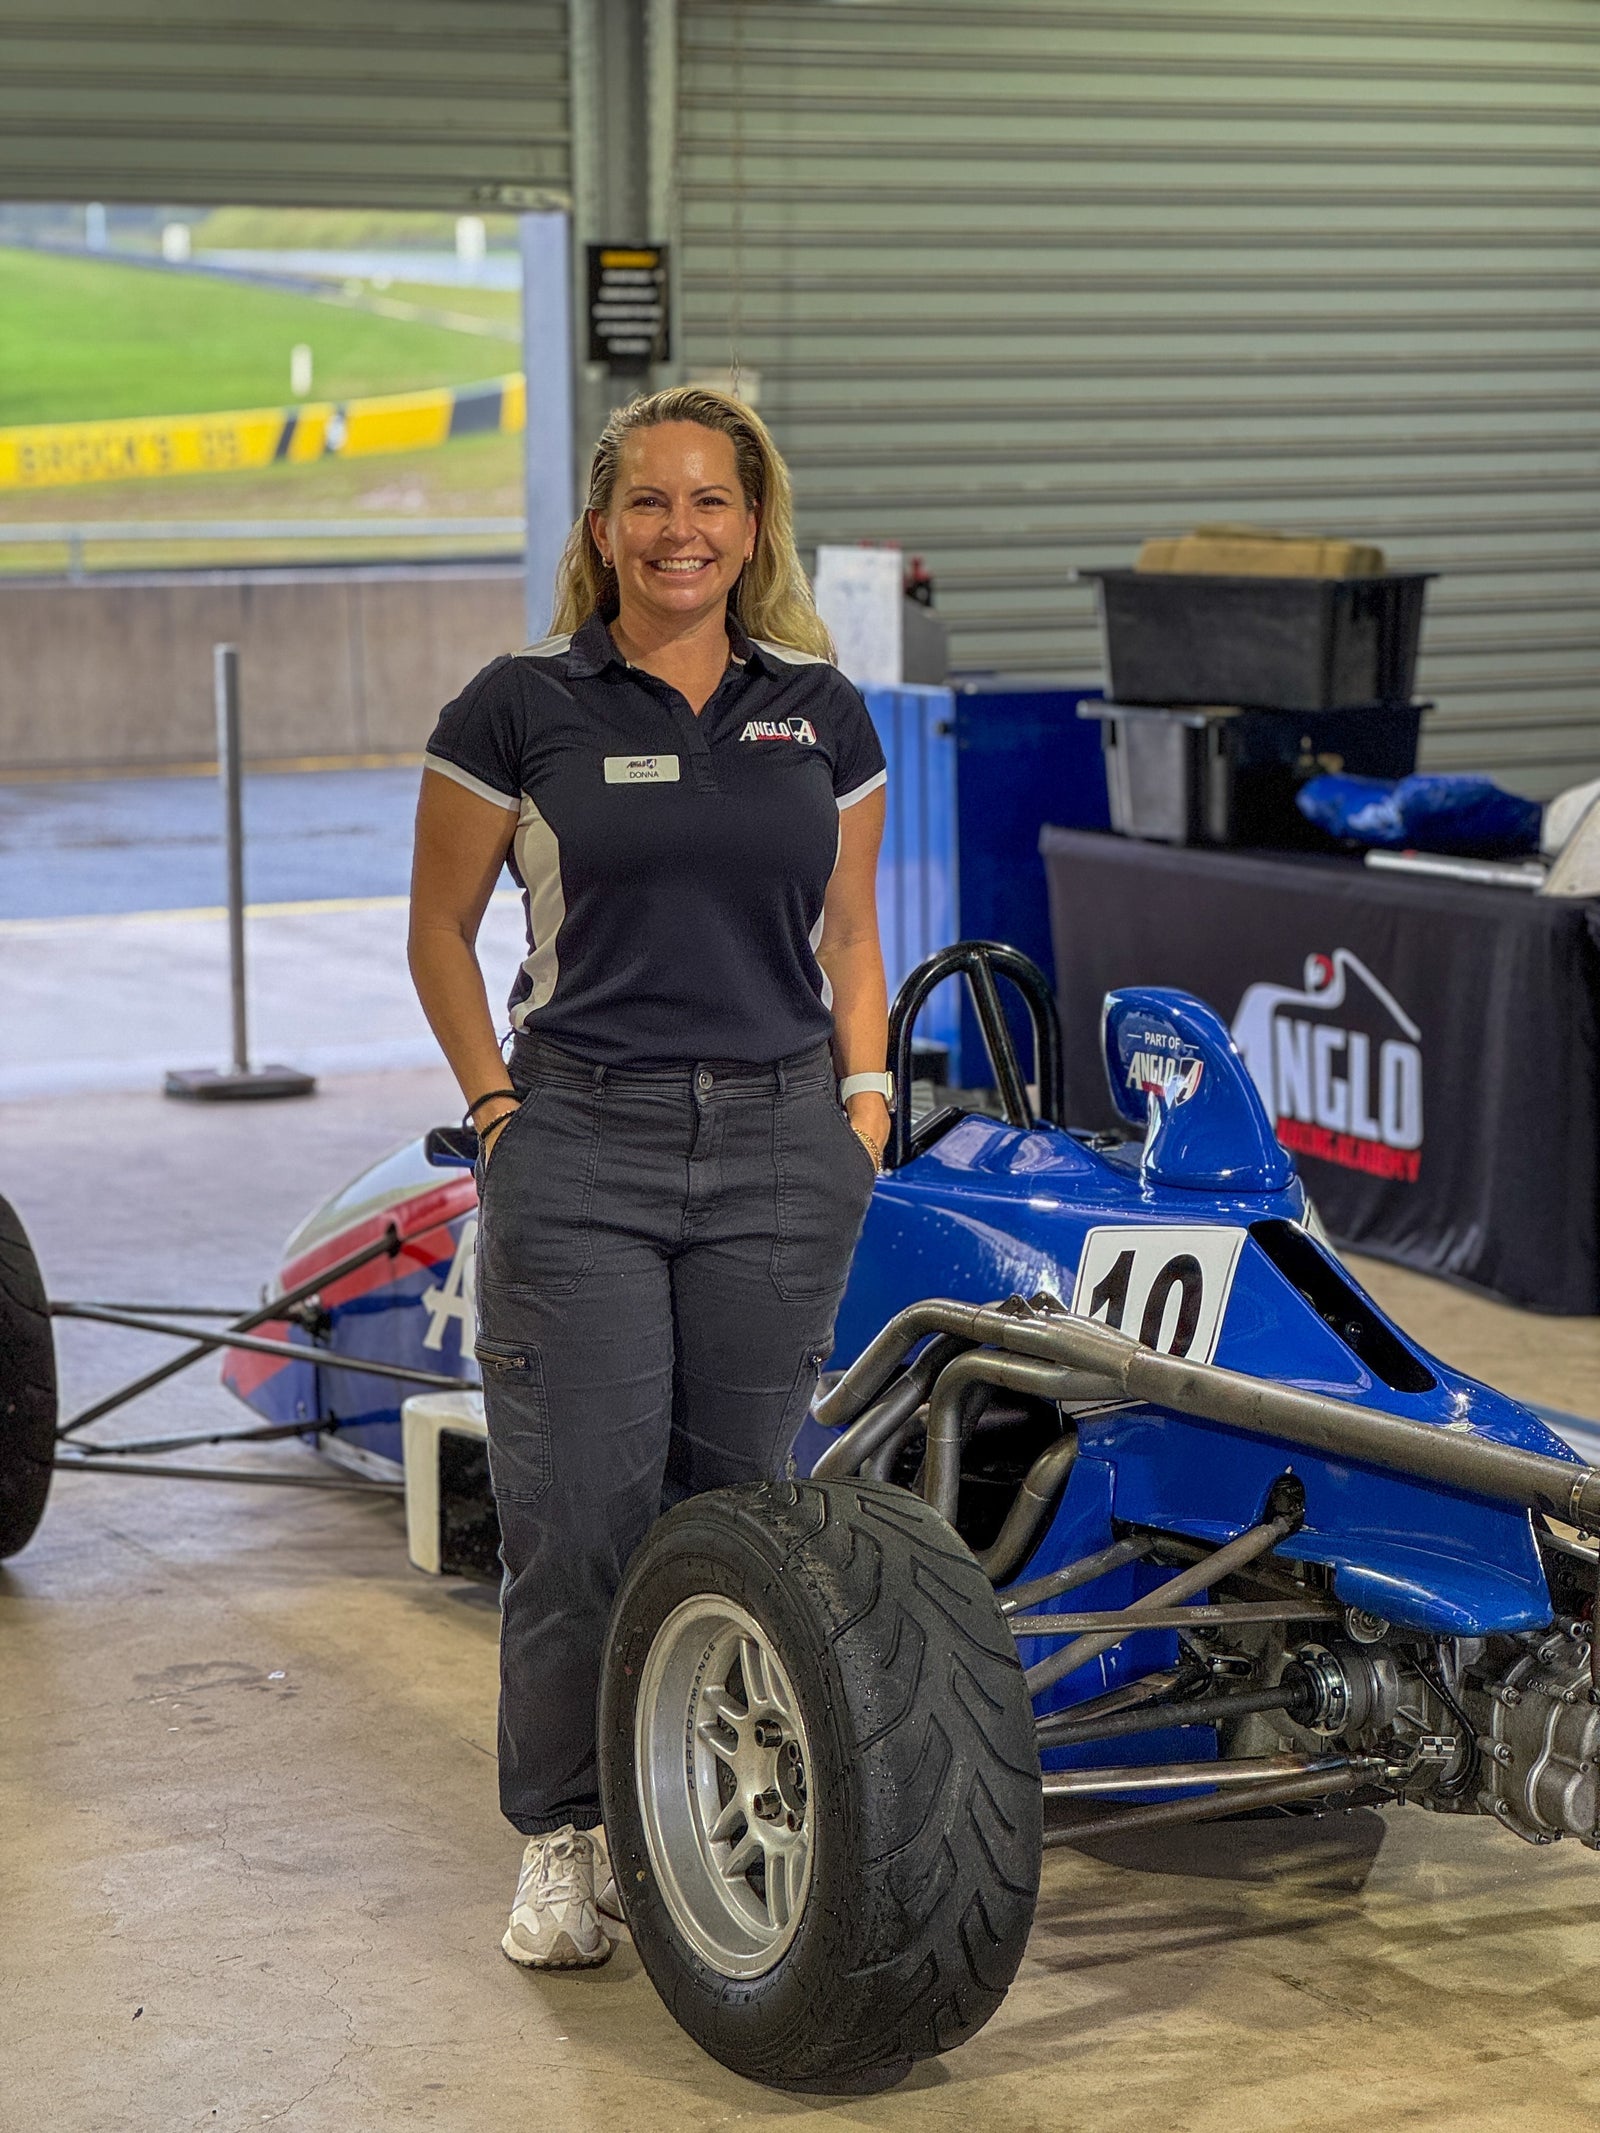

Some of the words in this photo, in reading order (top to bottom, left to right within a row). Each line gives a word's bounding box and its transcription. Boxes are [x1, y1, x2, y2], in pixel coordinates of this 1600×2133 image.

[738, 720, 791, 741] ANGLO
[629, 771, 659, 779] DONNA
[1144, 1031, 1167, 1047] PART
[1168, 1036, 1182, 1050] OF
[1125, 1051, 1176, 1091] ANGLO
[1089, 1250, 1203, 1358] 10
[685, 1642, 716, 1790] PERFORMANCE
